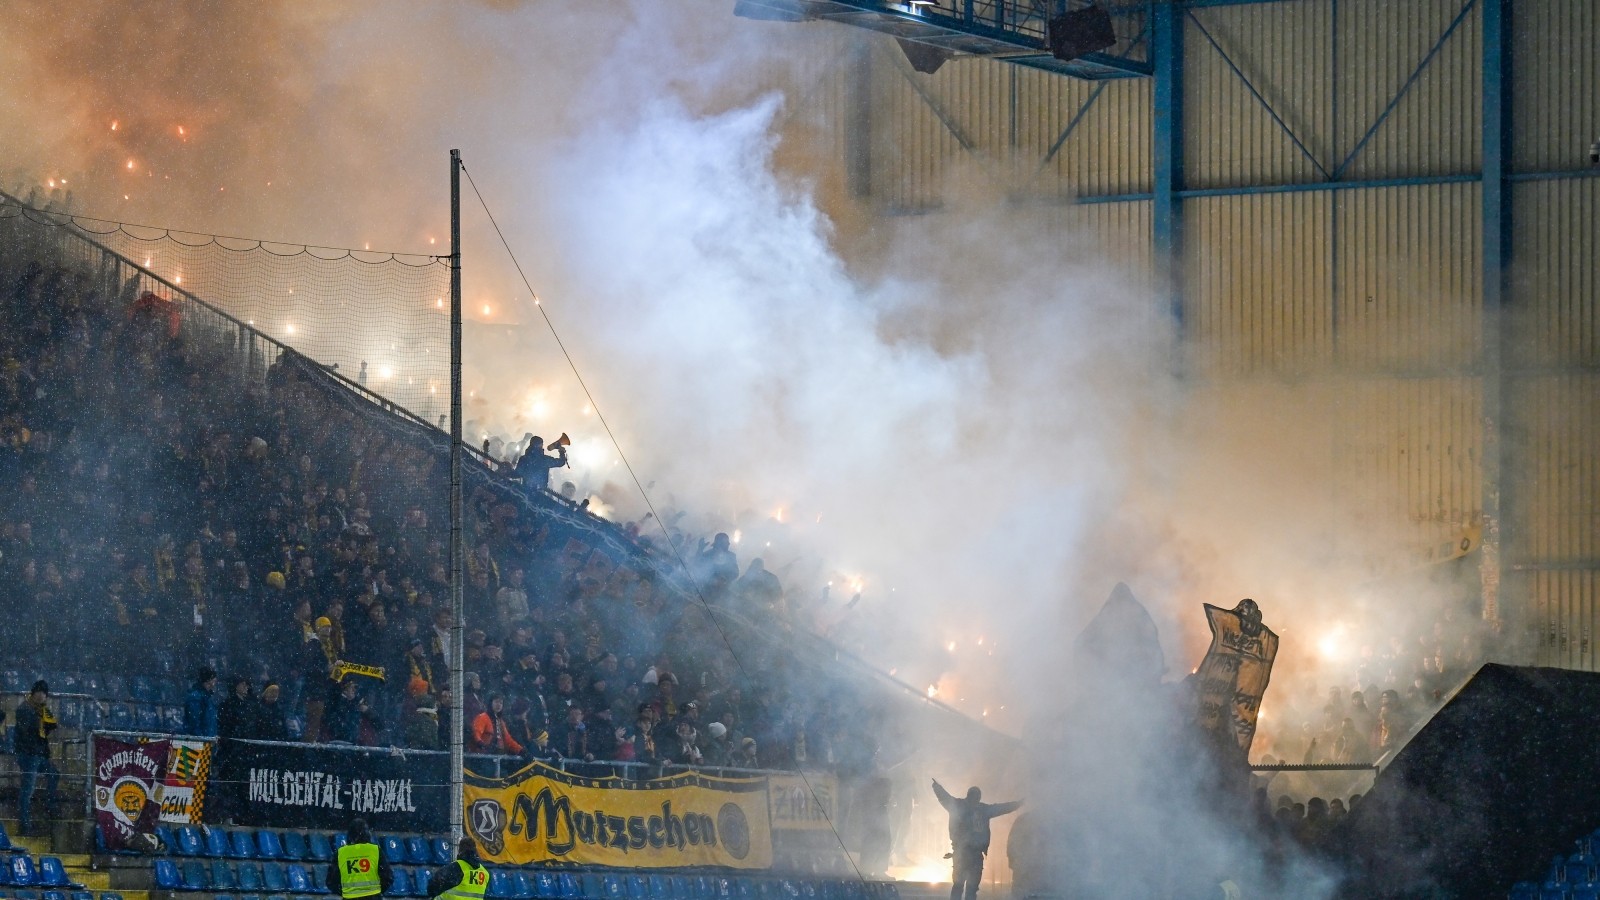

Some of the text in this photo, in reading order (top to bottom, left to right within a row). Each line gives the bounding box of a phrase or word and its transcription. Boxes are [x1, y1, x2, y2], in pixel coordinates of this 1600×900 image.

[509, 786, 717, 856] Mutzschen
[346, 858, 371, 874] K9
[469, 870, 485, 885] K9
